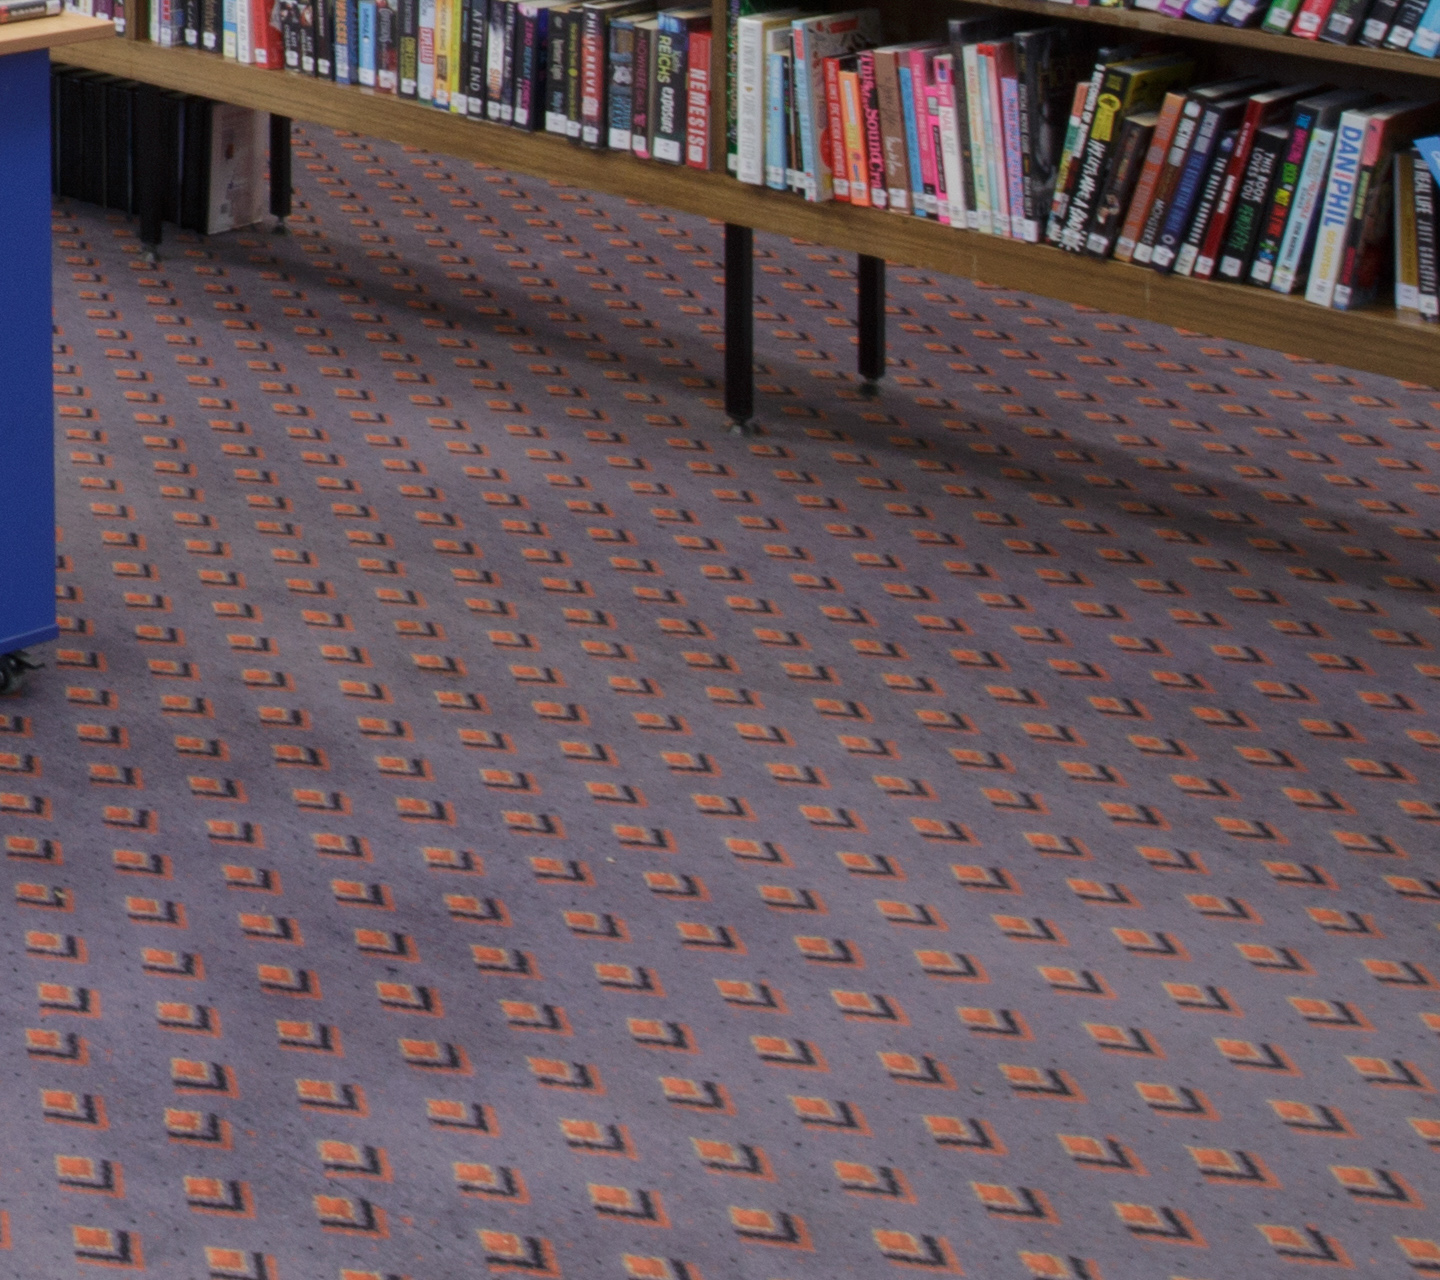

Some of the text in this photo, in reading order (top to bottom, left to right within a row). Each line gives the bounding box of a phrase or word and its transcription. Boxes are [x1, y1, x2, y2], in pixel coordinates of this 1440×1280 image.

[469, 9, 484, 93] AFTER END
[583, 12, 598, 96] PHILIP REEVE
[657, 35, 676, 134] REICHS exposure
[687, 68, 707, 149] NEMESIS
[1242, 178, 1255, 201] YOU
[1249, 146, 1265, 176] LOVES
[1255, 152, 1277, 204] THIS BOOK
[1323, 124, 1363, 227] DAN PHIL
